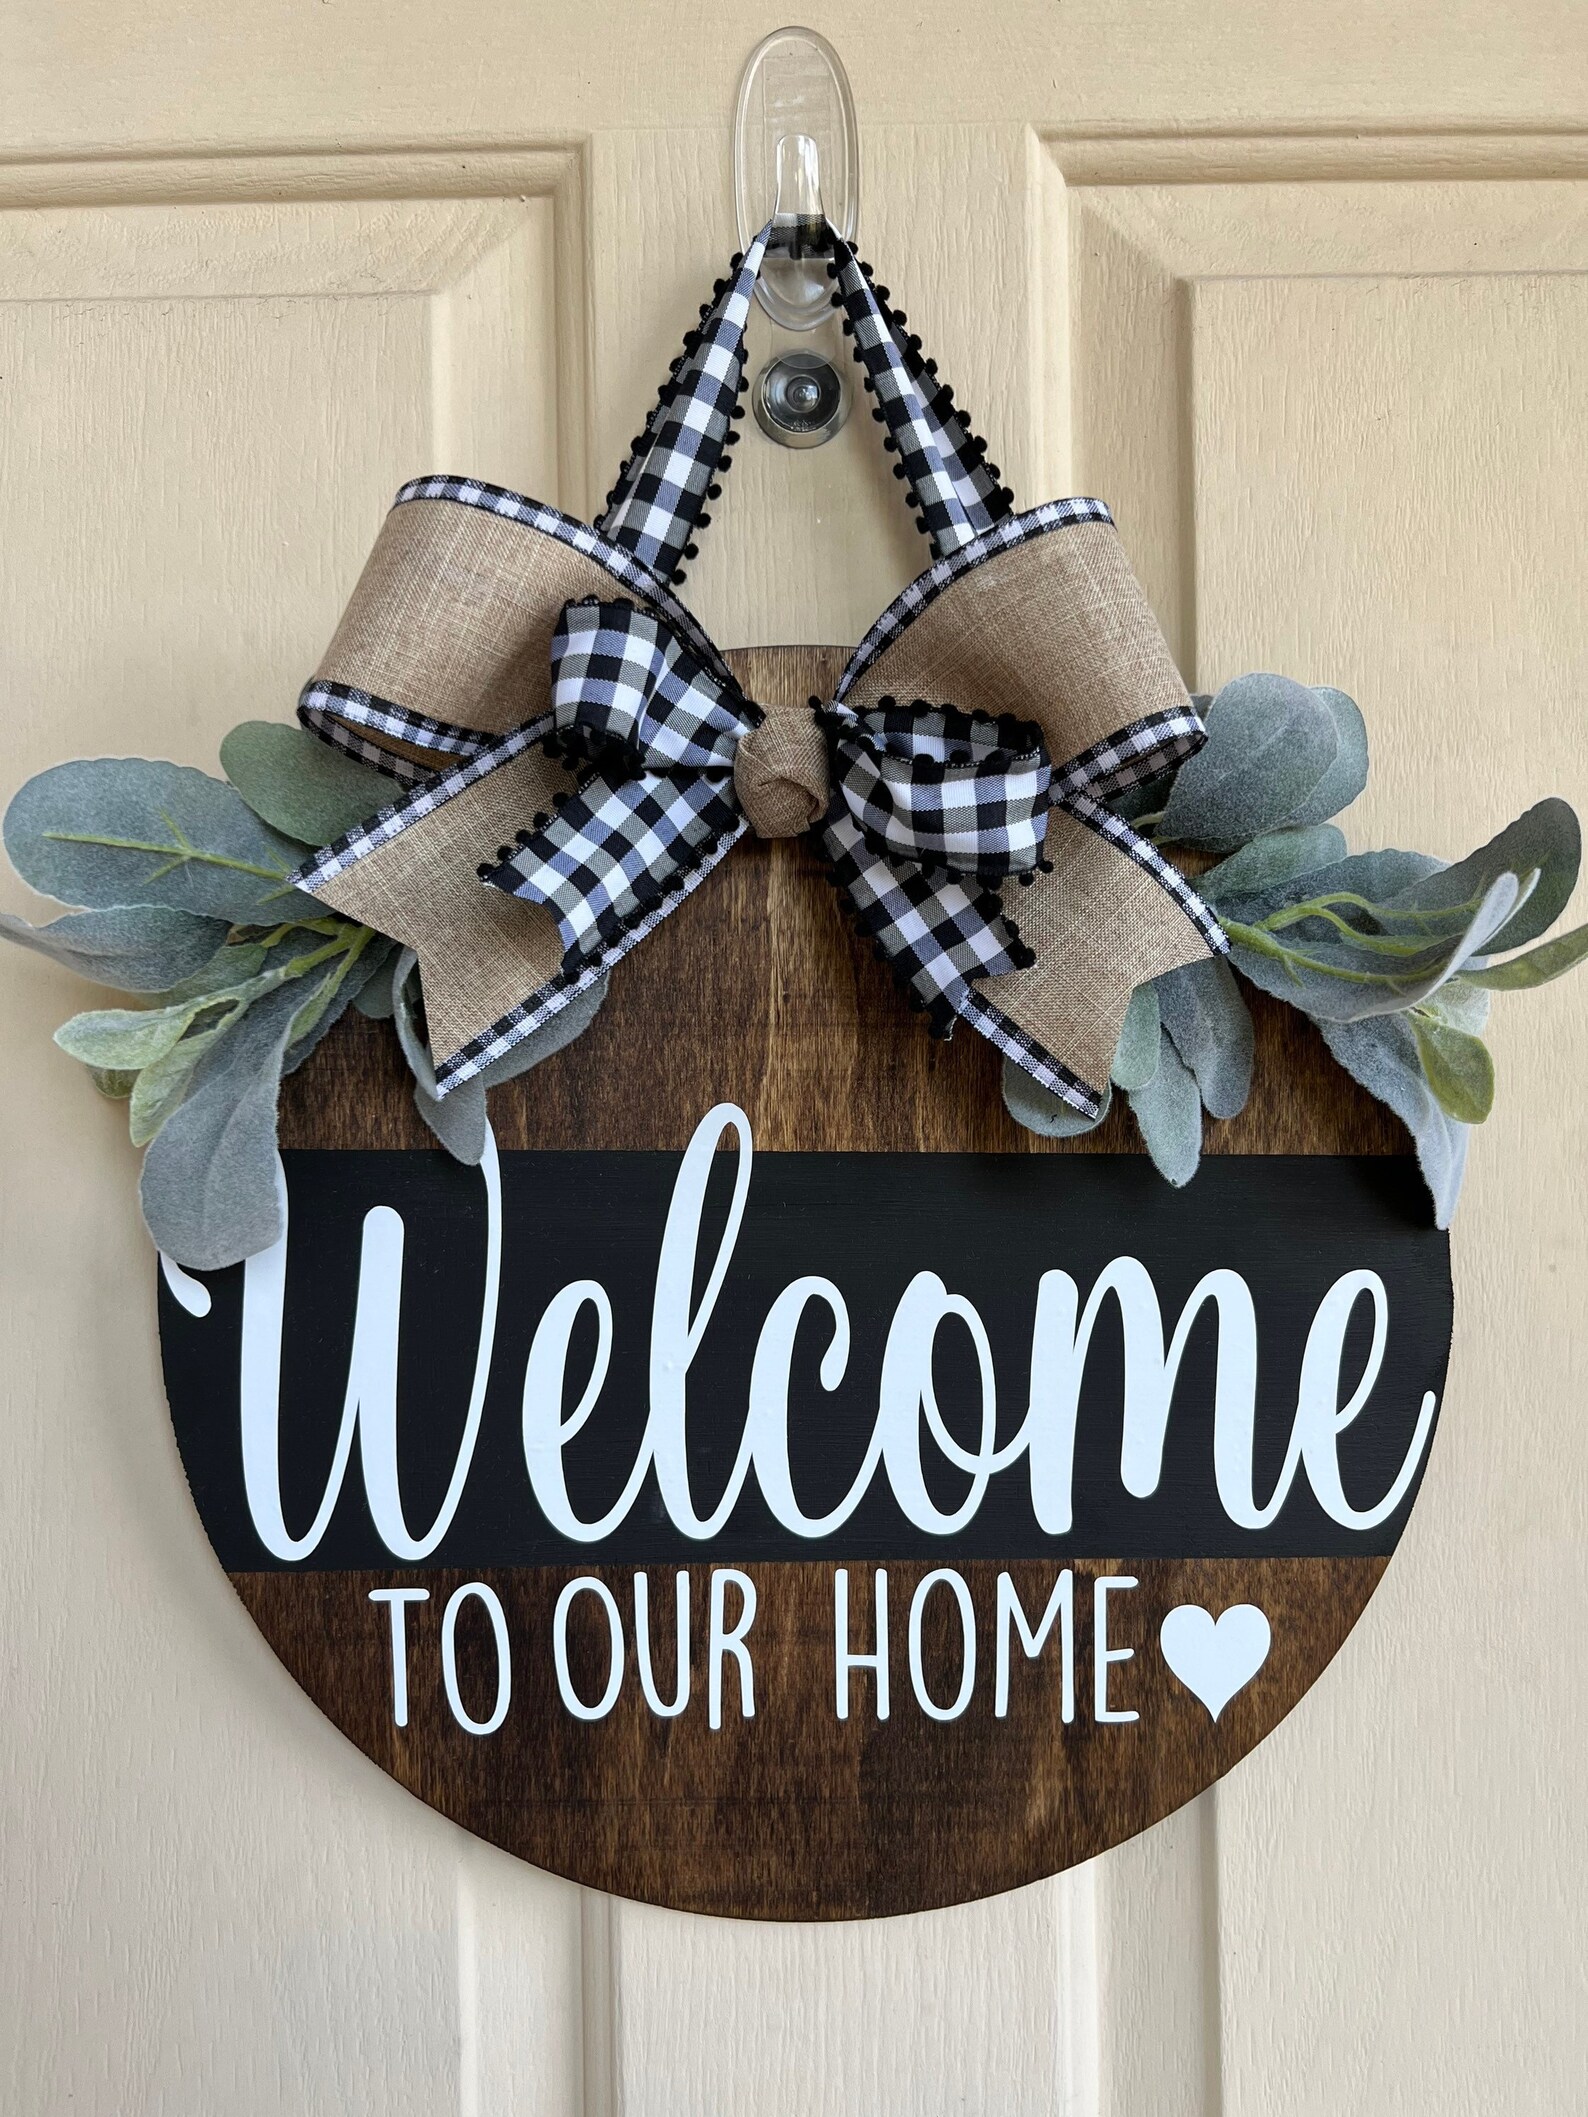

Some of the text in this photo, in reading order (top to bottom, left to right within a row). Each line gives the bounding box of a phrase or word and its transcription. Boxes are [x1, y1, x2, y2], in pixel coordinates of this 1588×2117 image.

[157, 1103, 1437, 1562] Welcome
[368, 1567, 1140, 1735] TO OUR HOME
